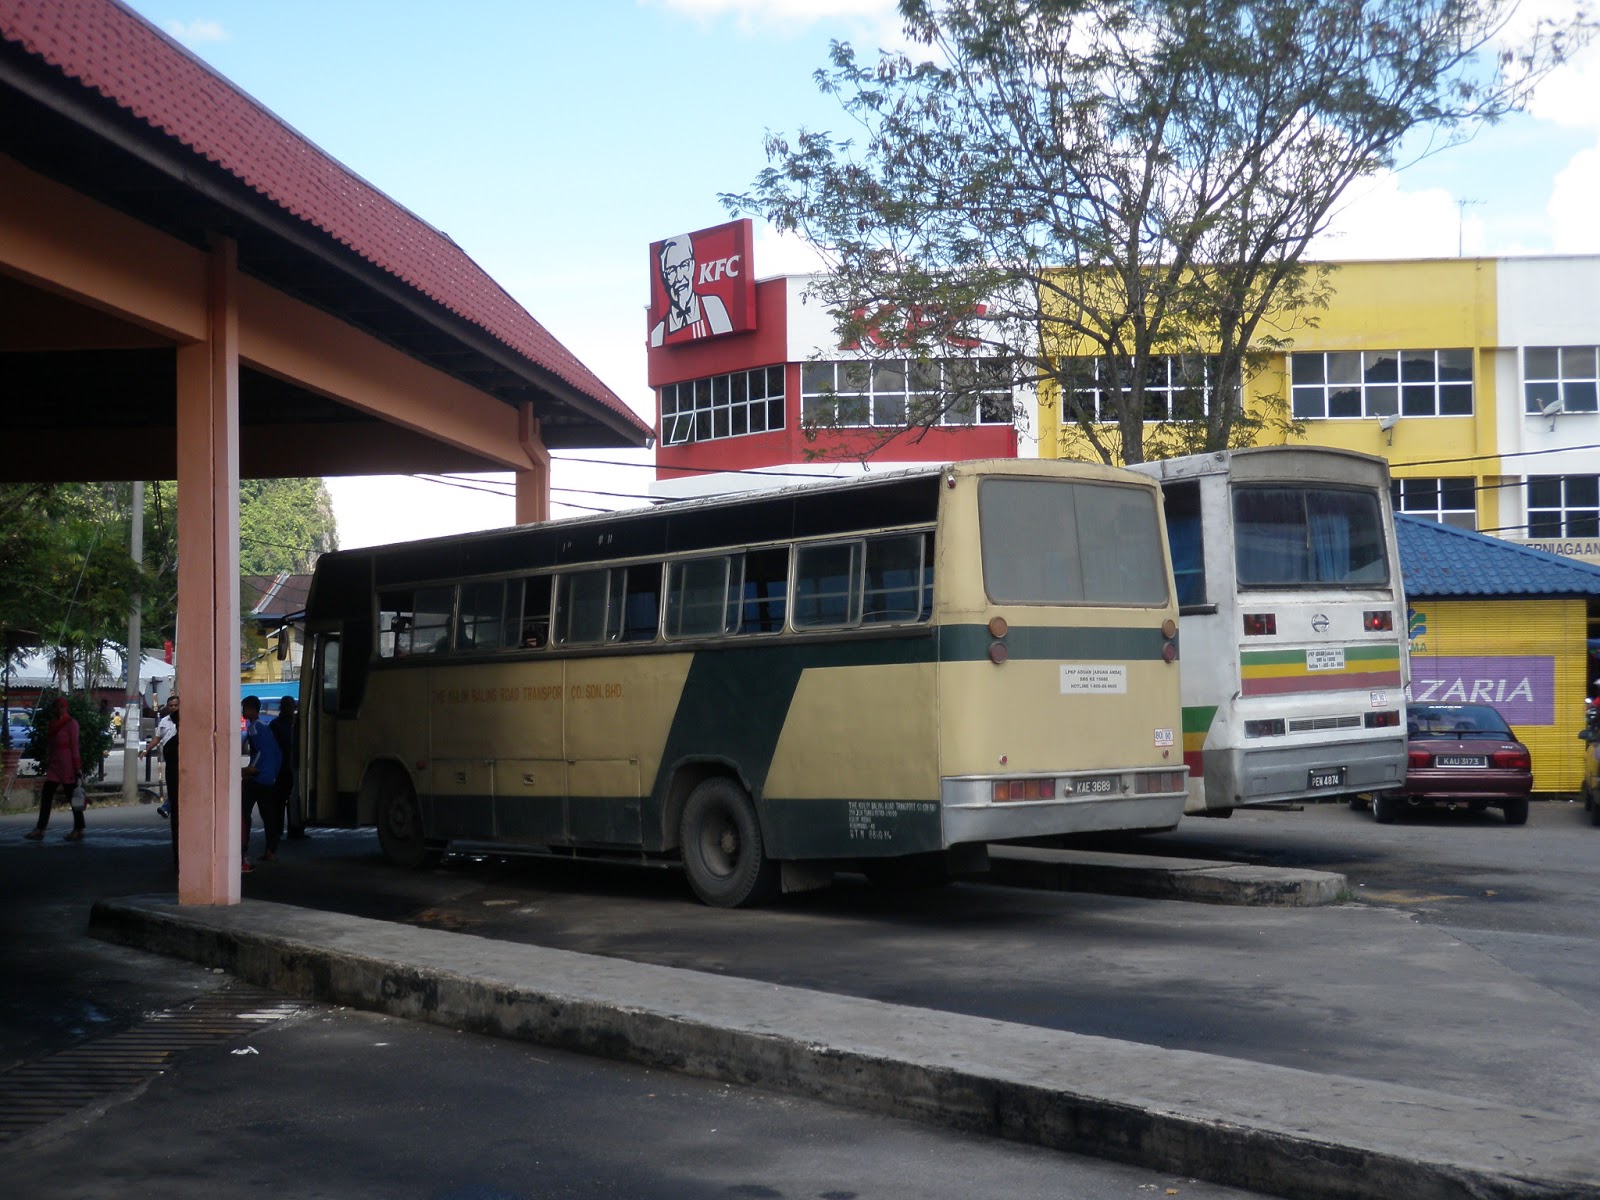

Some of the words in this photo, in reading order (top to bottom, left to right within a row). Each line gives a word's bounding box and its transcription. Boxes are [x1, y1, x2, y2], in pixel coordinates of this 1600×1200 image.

[698, 255, 740, 284] KFC
[500, 687, 520, 702] ROAD
[1444, 757, 1460, 765] KAU
[1461, 757, 1479, 765] 3173
[1076, 782, 1090, 794] KAE
[1091, 780, 1111, 792] 3689
